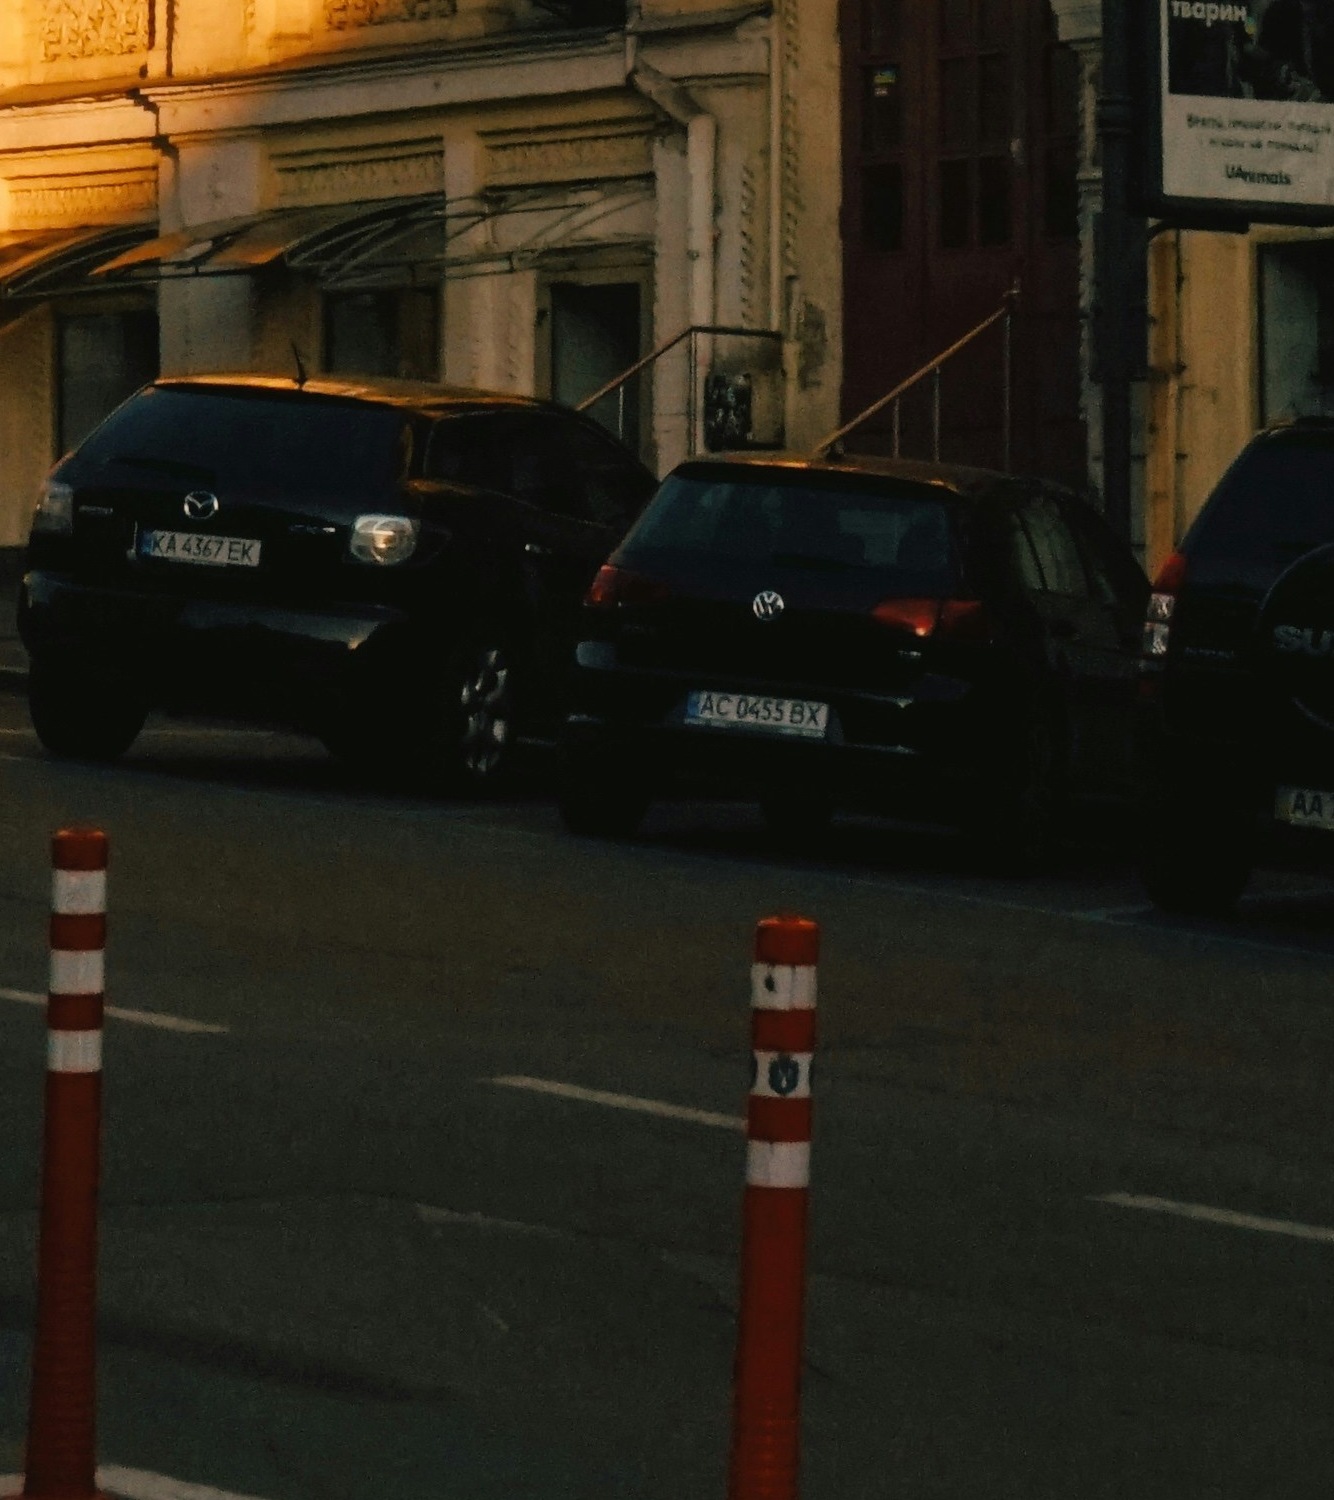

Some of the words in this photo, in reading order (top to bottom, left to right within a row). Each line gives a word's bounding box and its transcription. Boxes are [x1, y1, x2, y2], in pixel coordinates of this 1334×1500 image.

[1171, 0, 1247, 28] тварин
[182, 534, 224, 559] 4367
[737, 696, 786, 722] 0455
